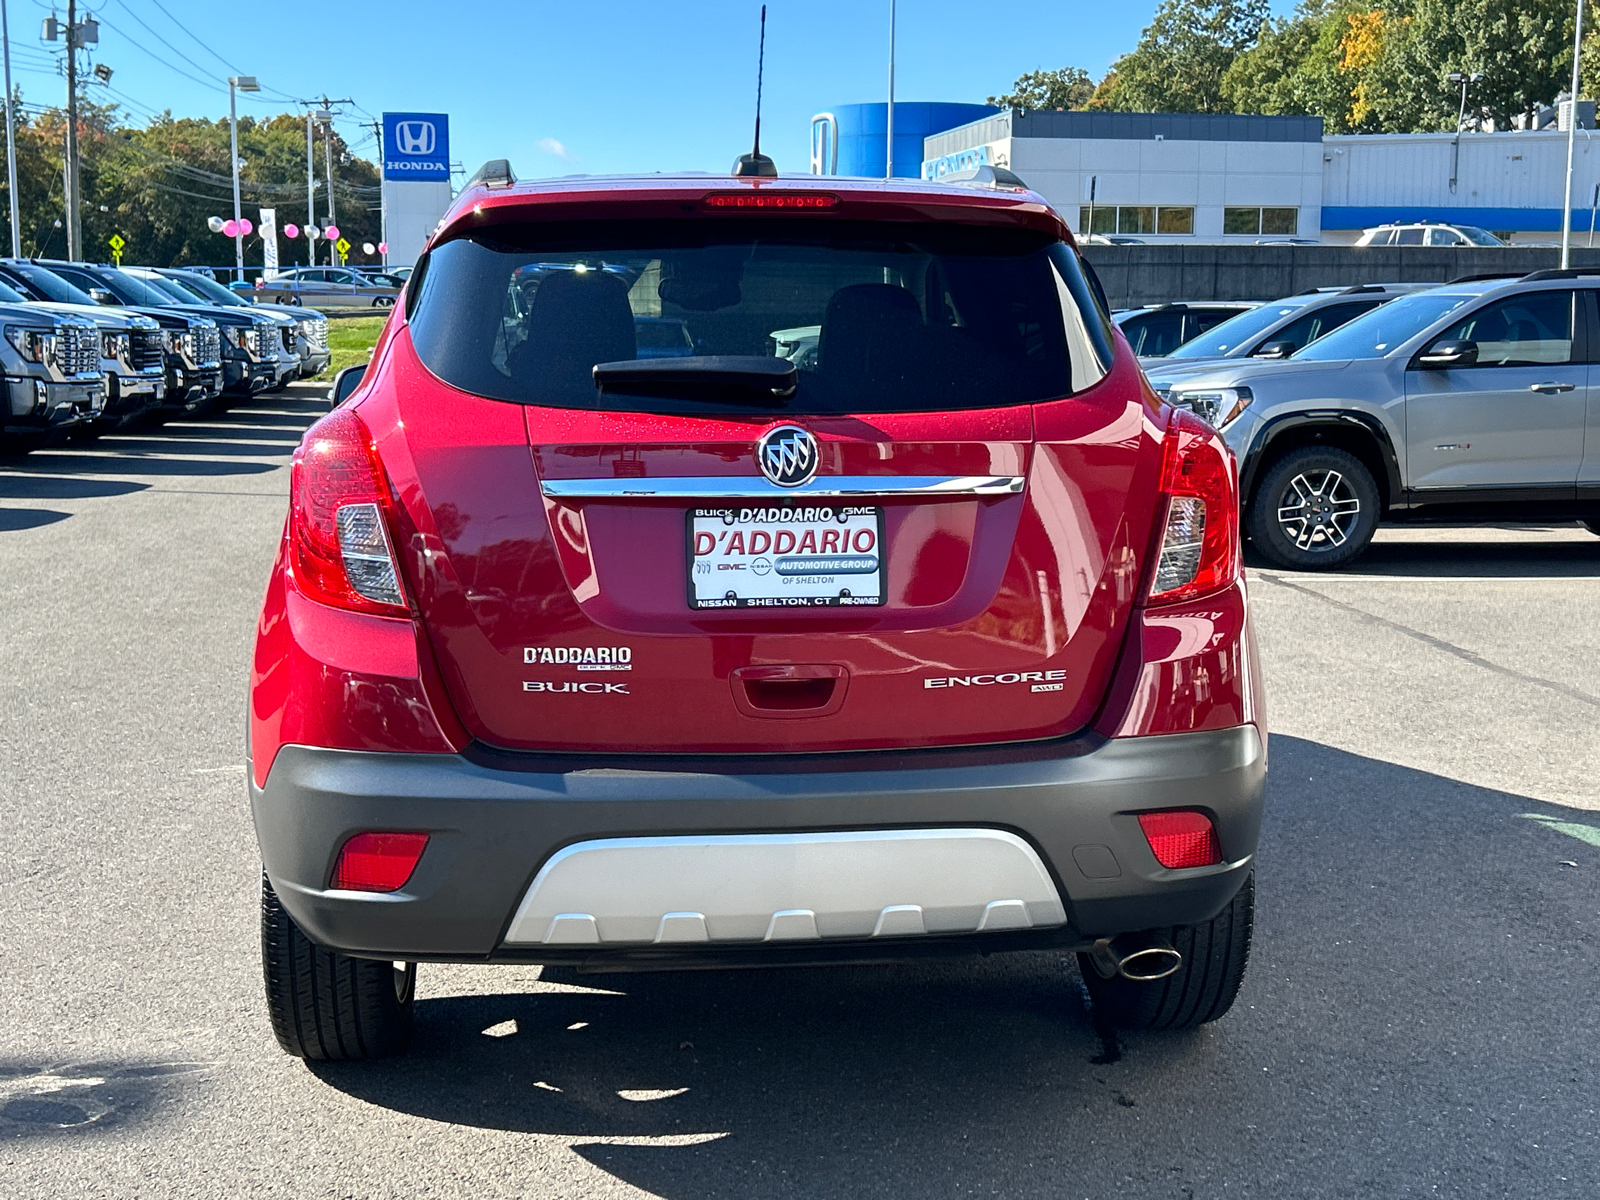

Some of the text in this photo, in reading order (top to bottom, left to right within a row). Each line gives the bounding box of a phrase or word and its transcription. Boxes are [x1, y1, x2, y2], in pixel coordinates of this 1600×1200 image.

[386, 161, 447, 171] HONDA
[695, 509, 733, 517] BUICK
[739, 507, 833, 523] D'ADDARIO
[842, 506, 876, 515] GMC
[694, 528, 876, 556] D'ADDARIO
[717, 563, 747, 571] GMC
[780, 560, 874, 570] AUTOMOTIVE GROUP
[782, 576, 835, 585] OF SHELTON
[697, 600, 737, 608] NISSAN
[814, 597, 832, 605] CT
[839, 597, 879, 605] PRE-OWNED
[523, 647, 632, 664] D'ADDARIO
[924, 669, 1067, 689] ENCORE
[522, 681, 630, 694] BUICK
